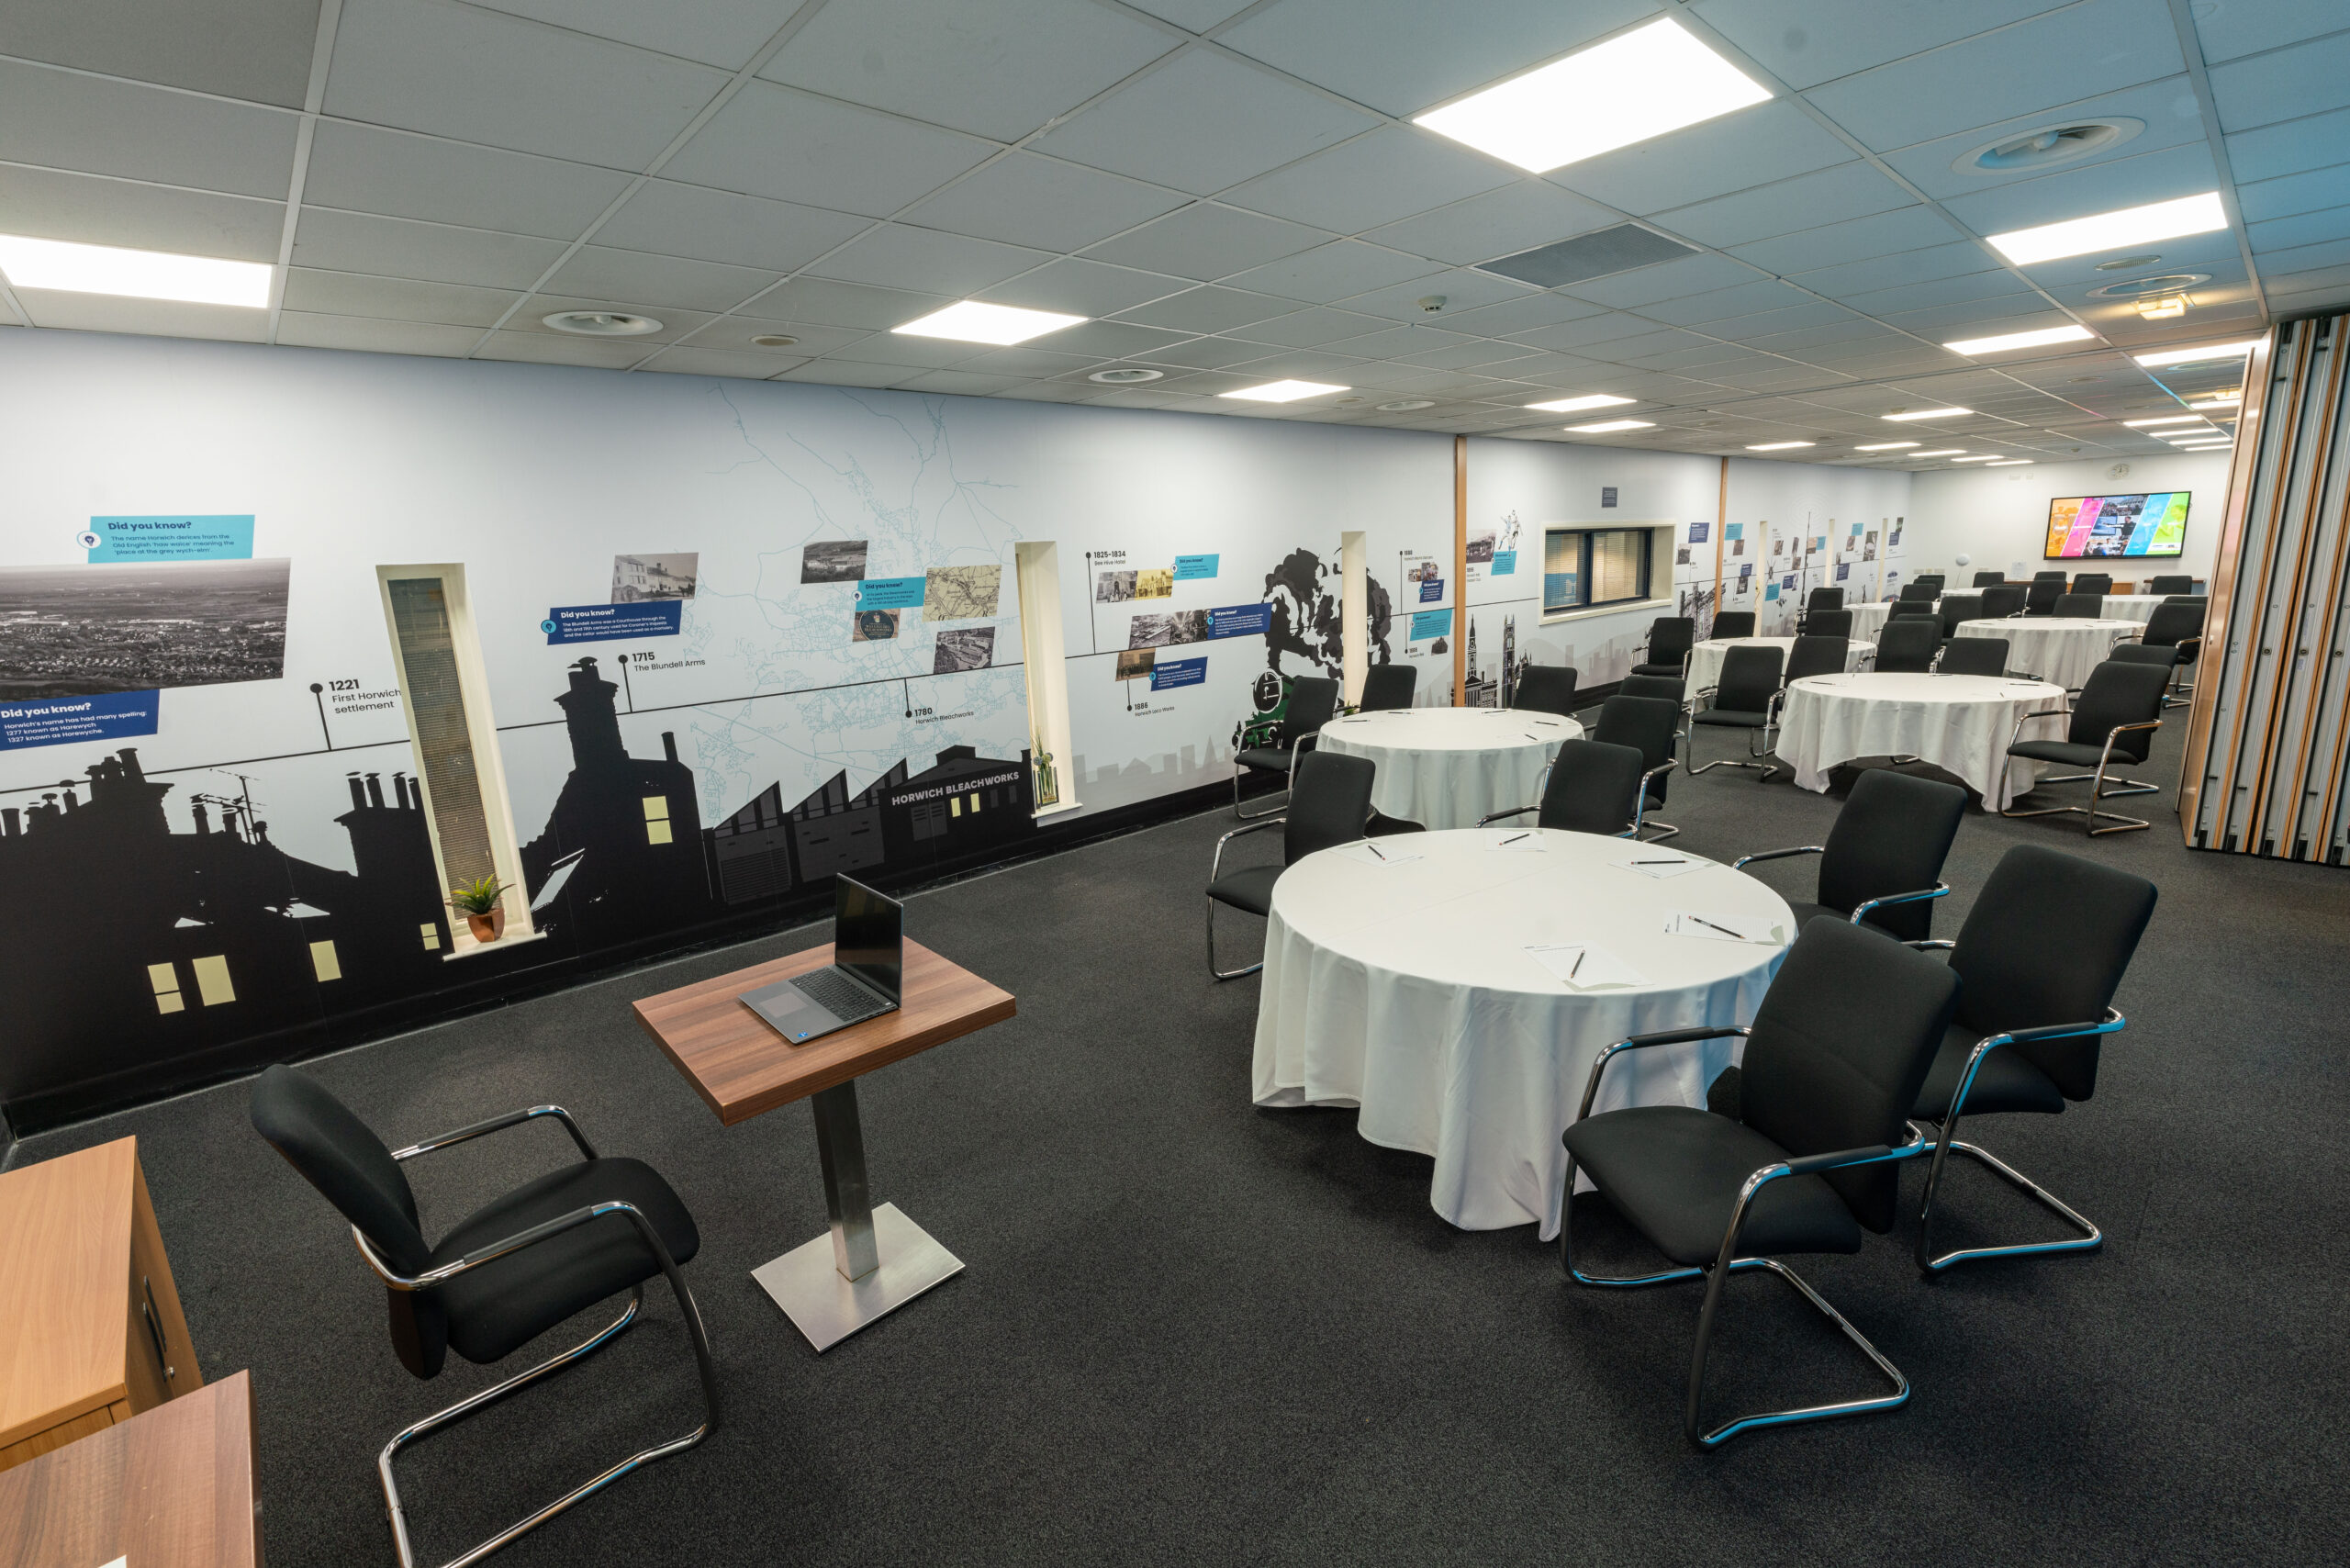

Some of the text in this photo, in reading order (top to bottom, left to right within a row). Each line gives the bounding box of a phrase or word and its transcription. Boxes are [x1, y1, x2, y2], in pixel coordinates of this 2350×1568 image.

[632, 652, 655, 662] 1715
[651, 661, 683, 670] Blundell
[329, 678, 360, 691] 1221
[332, 689, 401, 703] First Horwich
[1, 702, 92, 718] Did you know?
[334, 700, 395, 714] settlement
[914, 708, 933, 717] 1780
[940, 711, 974, 721] Bleachworks
[61, 722, 96, 732] Harewych
[62, 729, 105, 738] Horewyche.
[891, 771, 1019, 806] HORWICH BLEACHWORKS
